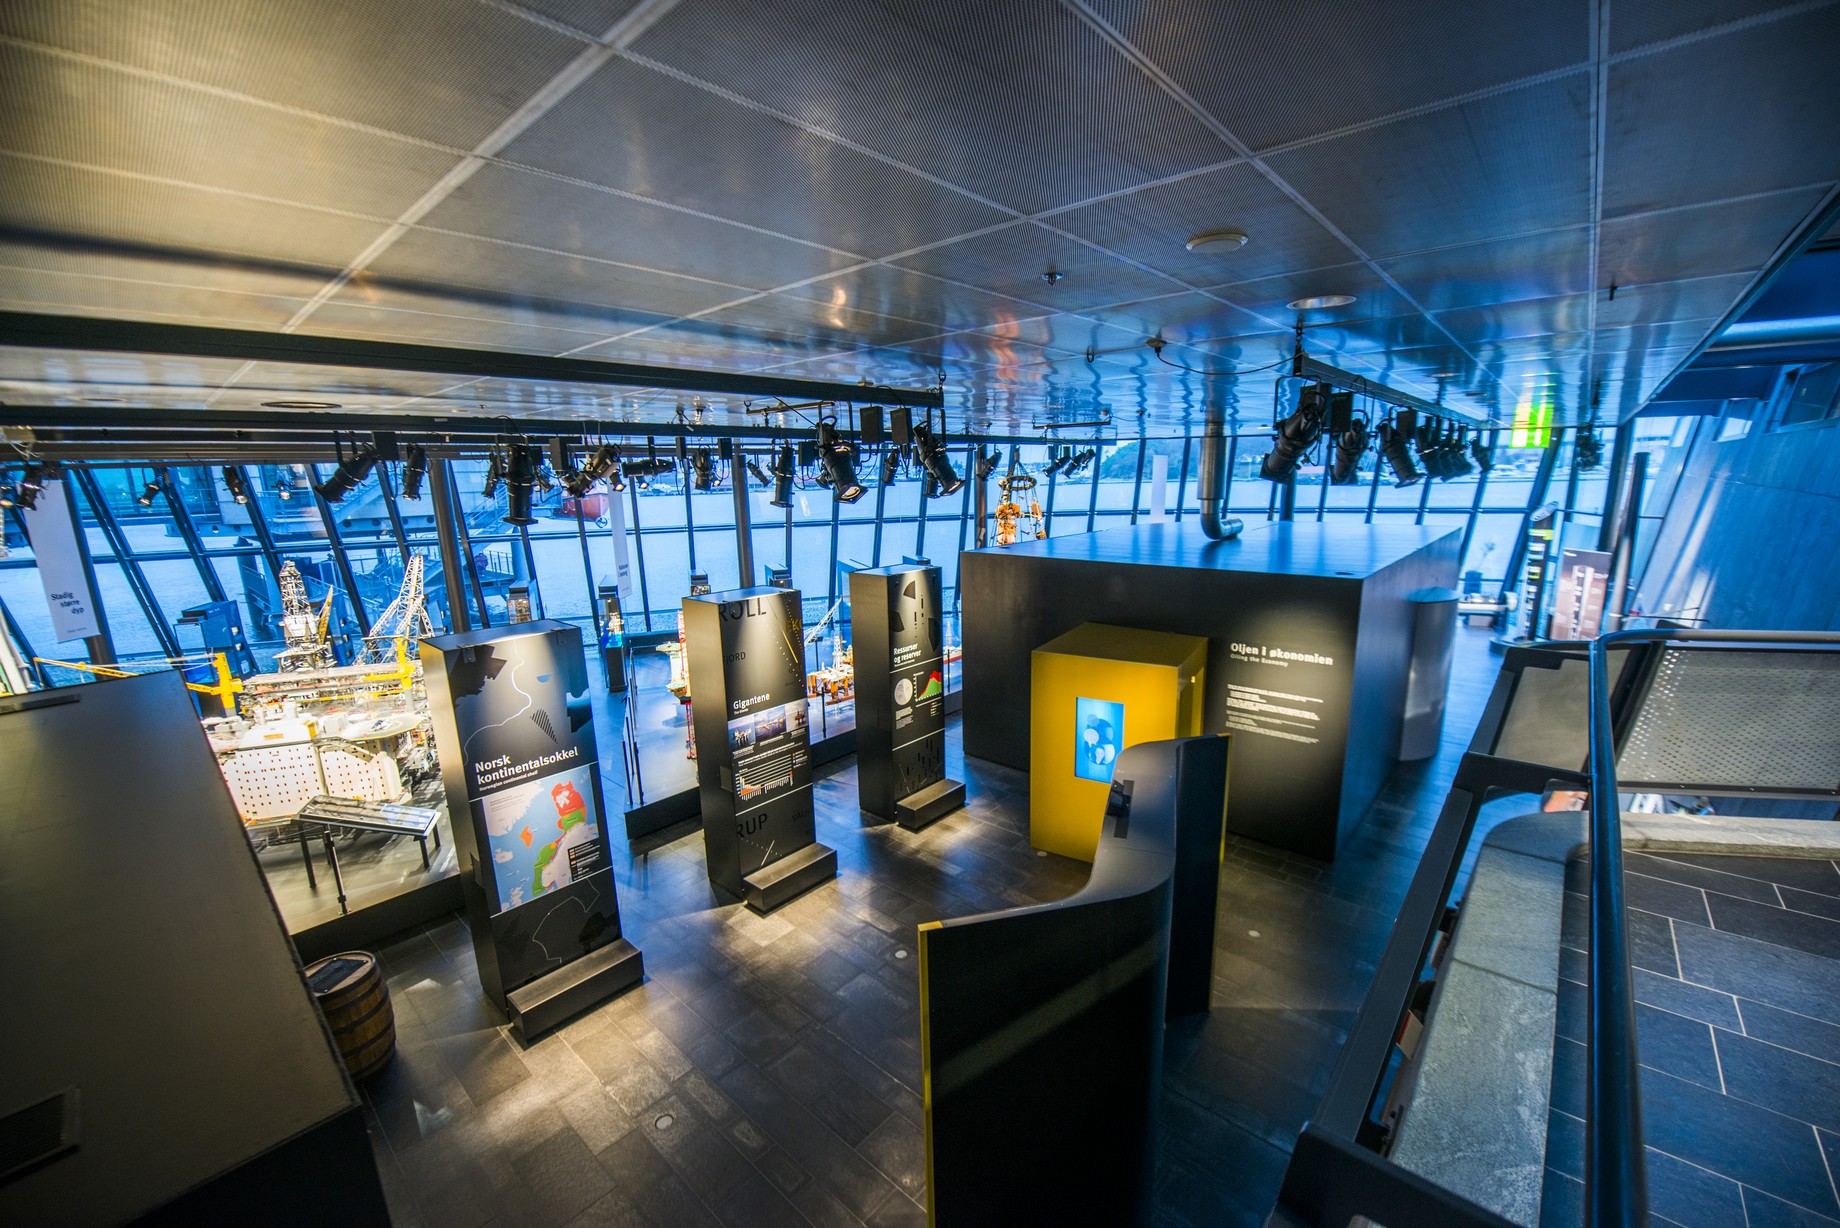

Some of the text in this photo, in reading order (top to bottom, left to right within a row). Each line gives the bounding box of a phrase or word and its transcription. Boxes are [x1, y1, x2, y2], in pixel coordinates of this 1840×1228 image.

[50, 592, 74, 601] Stadig
[893, 643, 919, 655] Ressurser
[893, 655, 901, 664] og
[901, 649, 922, 661] reserver
[1230, 642, 1334, 667] Oljen i økonomien
[733, 693, 771, 710] Gigantene
[475, 754, 512, 773] Norsk
[477, 746, 579, 785] kontinentalsokkel
[479, 781, 504, 792] Norwegian
